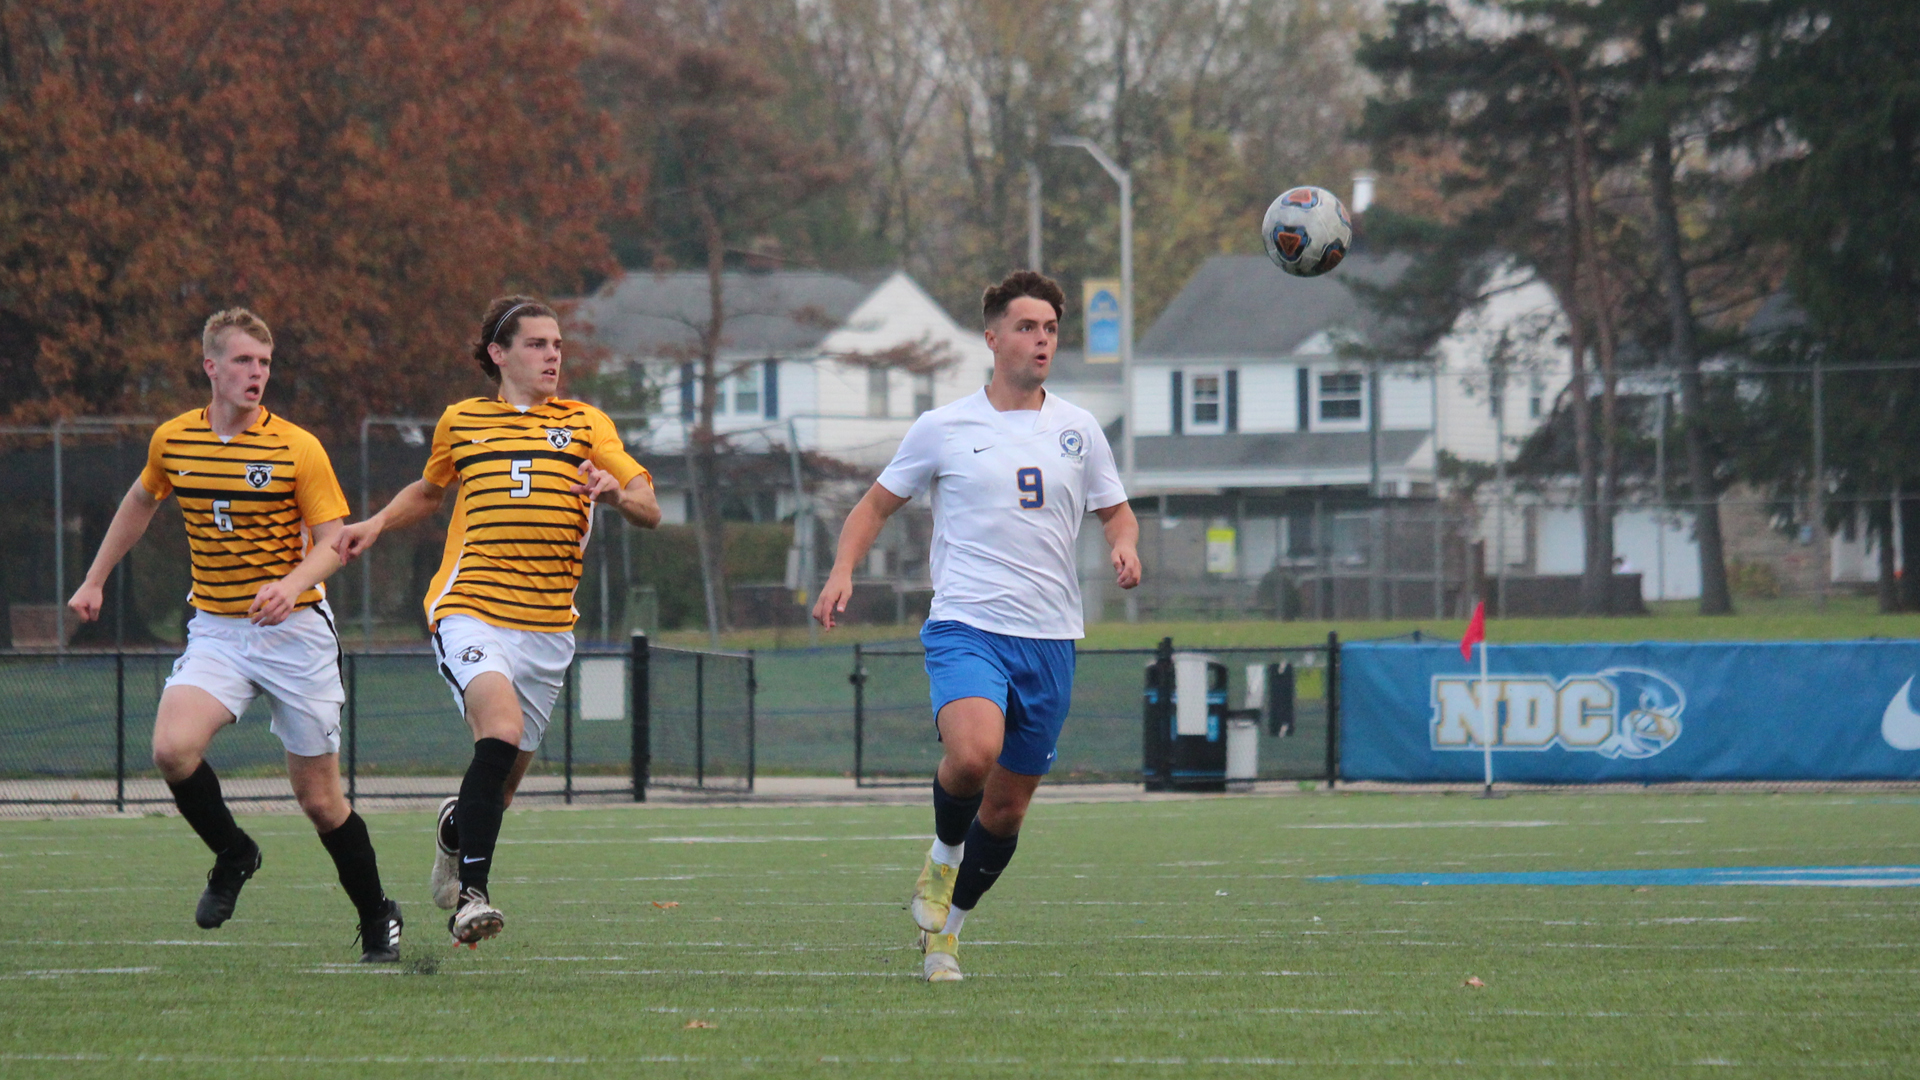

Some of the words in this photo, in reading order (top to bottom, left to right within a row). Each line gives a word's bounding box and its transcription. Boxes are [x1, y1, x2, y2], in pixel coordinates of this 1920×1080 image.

[510, 459, 532, 498] 5
[1016, 466, 1045, 510] 9
[212, 500, 234, 532] 6
[1434, 677, 1616, 748] NDC
